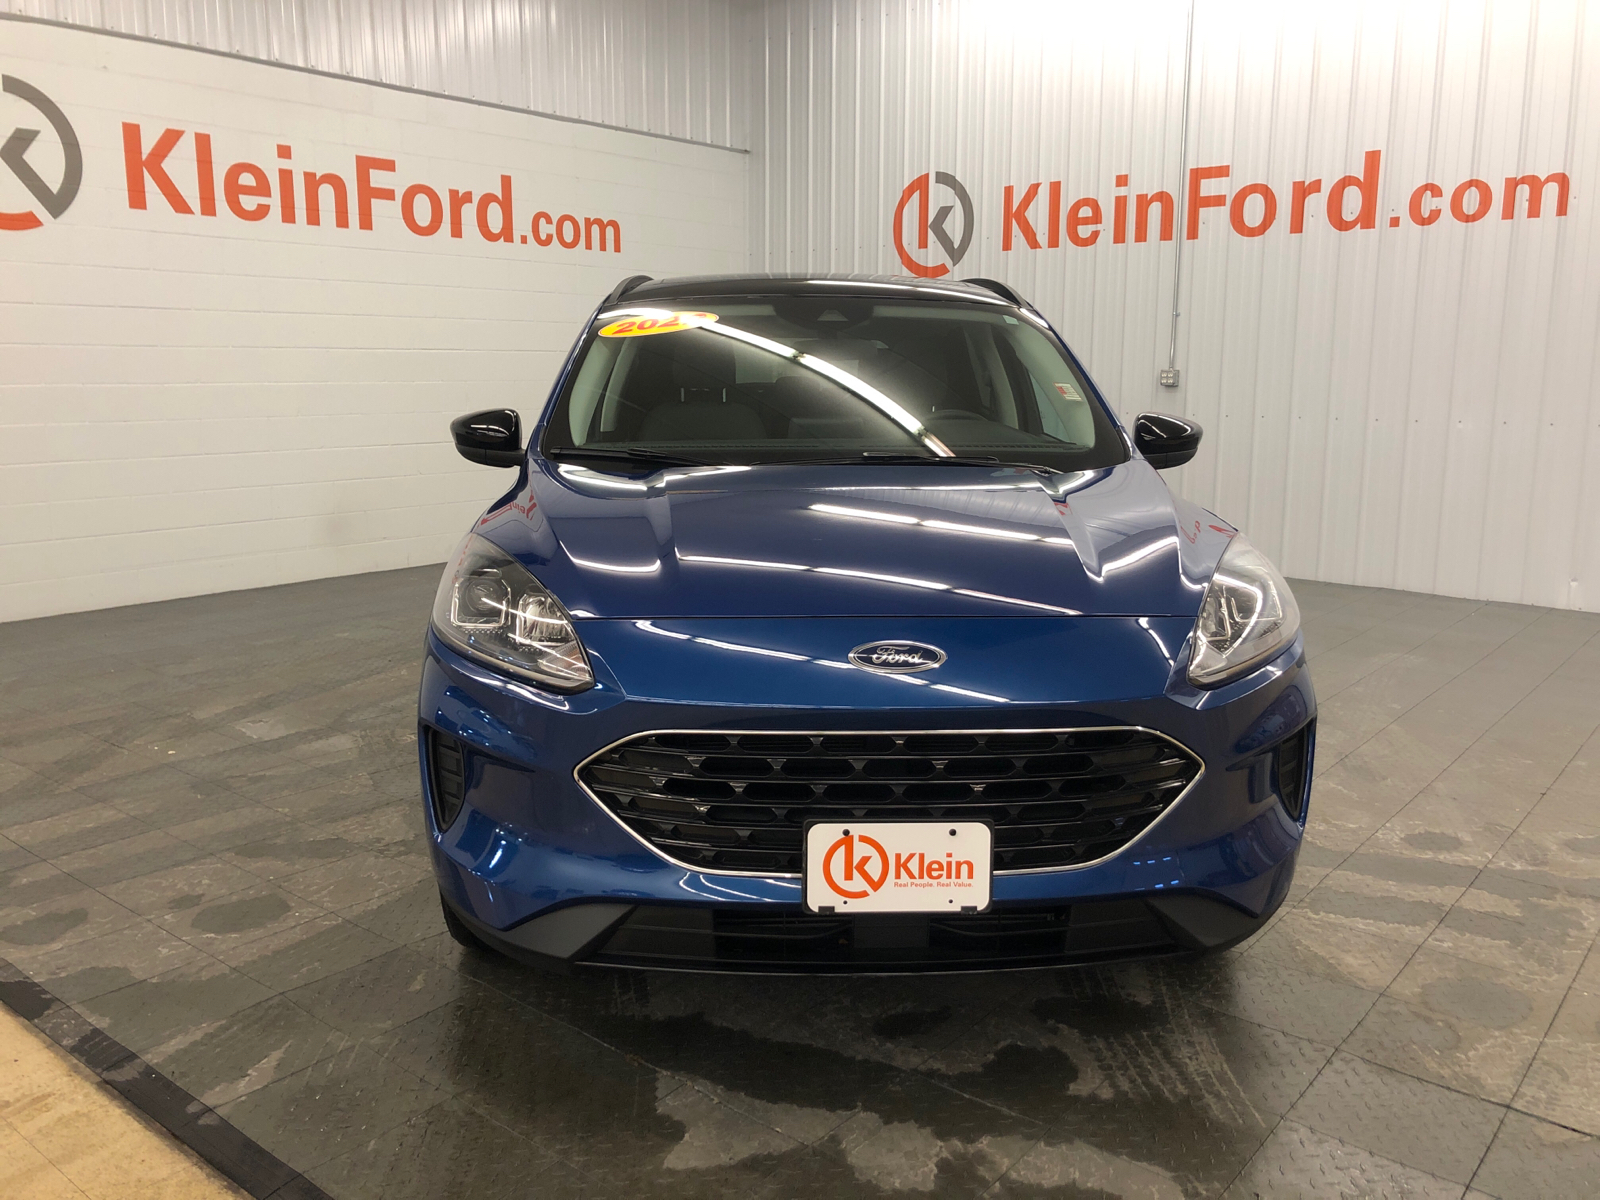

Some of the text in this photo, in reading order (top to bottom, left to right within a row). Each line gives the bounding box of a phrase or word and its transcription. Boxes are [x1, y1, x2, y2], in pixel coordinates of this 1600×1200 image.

[121, 121, 622, 254] KleinFord.com
[1001, 149, 1571, 252] KleinFord.com
[872, 645, 923, 664] Ford
[894, 852, 974, 880] Klein
[910, 881, 935, 889] People.
